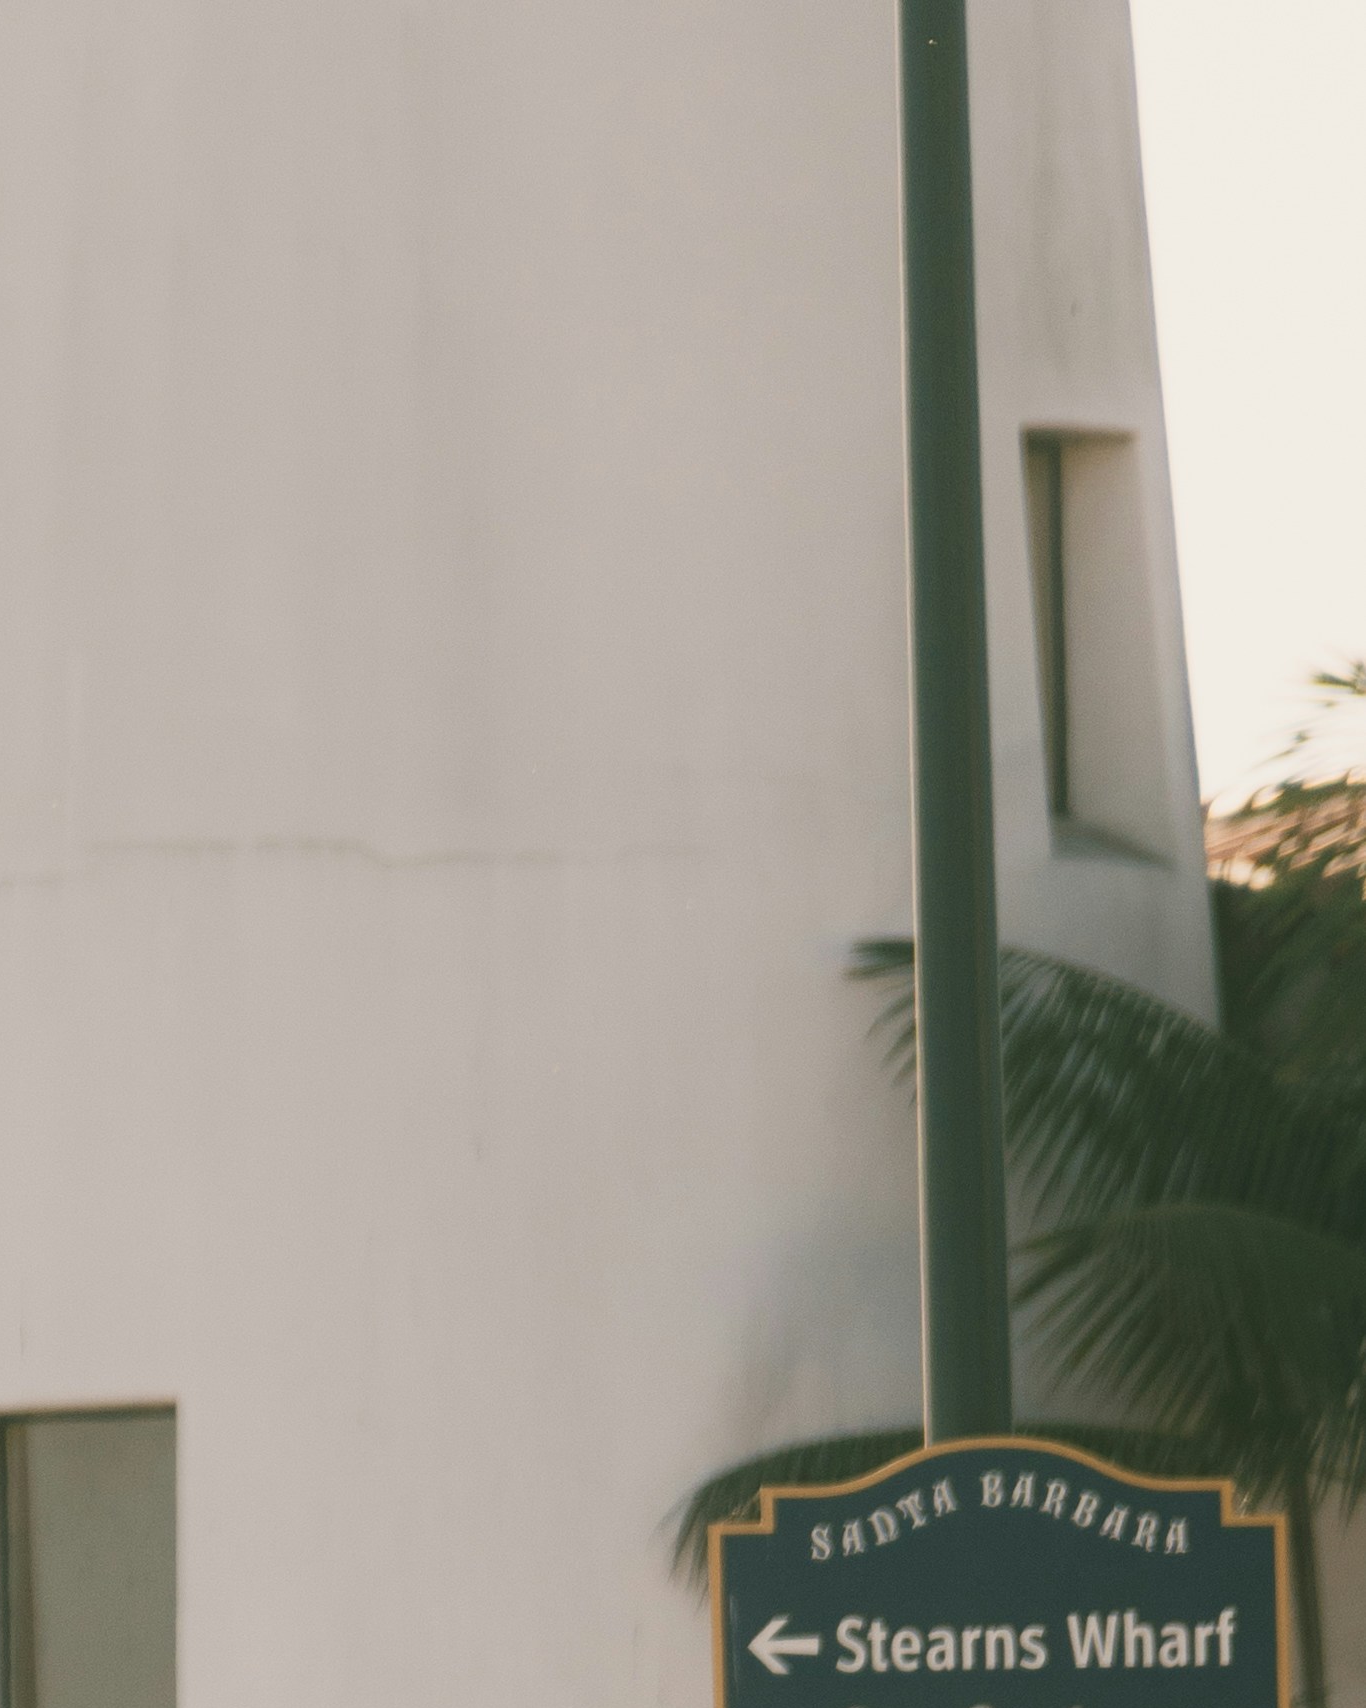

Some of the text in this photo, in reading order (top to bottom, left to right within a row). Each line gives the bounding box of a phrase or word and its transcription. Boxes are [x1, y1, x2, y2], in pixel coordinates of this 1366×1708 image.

[811, 1469, 1190, 1561] SANTA BARBARA
[836, 1608, 1236, 1673] Stearns Wharf
